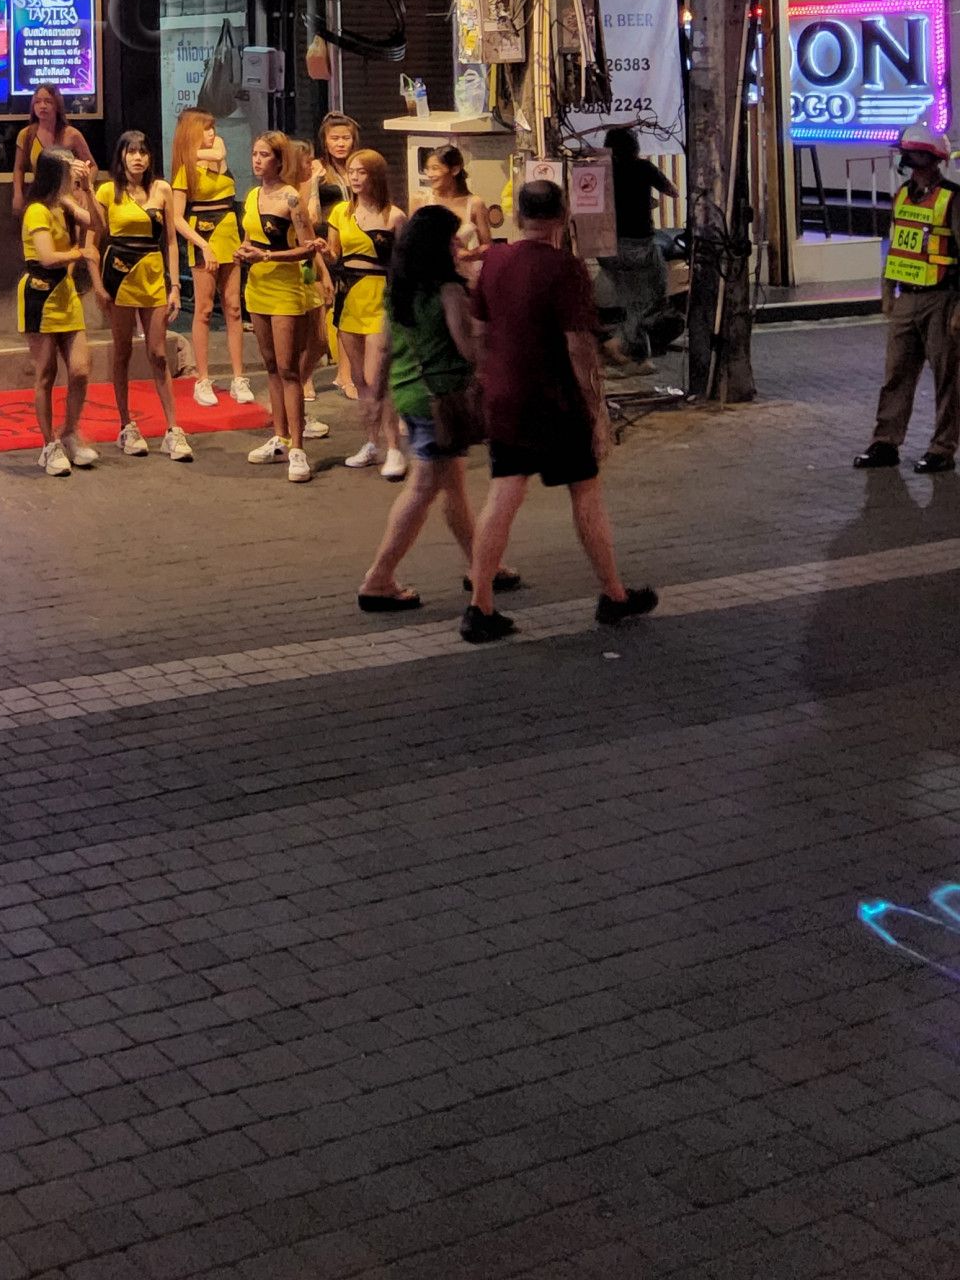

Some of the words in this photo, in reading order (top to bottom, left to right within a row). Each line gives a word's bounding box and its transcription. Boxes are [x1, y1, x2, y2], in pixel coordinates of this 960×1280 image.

[25, 6, 79, 25] TANTRA
[617, 14, 654, 27] BEER
[790, 15, 929, 91] ON
[897, 229, 918, 250] 645
